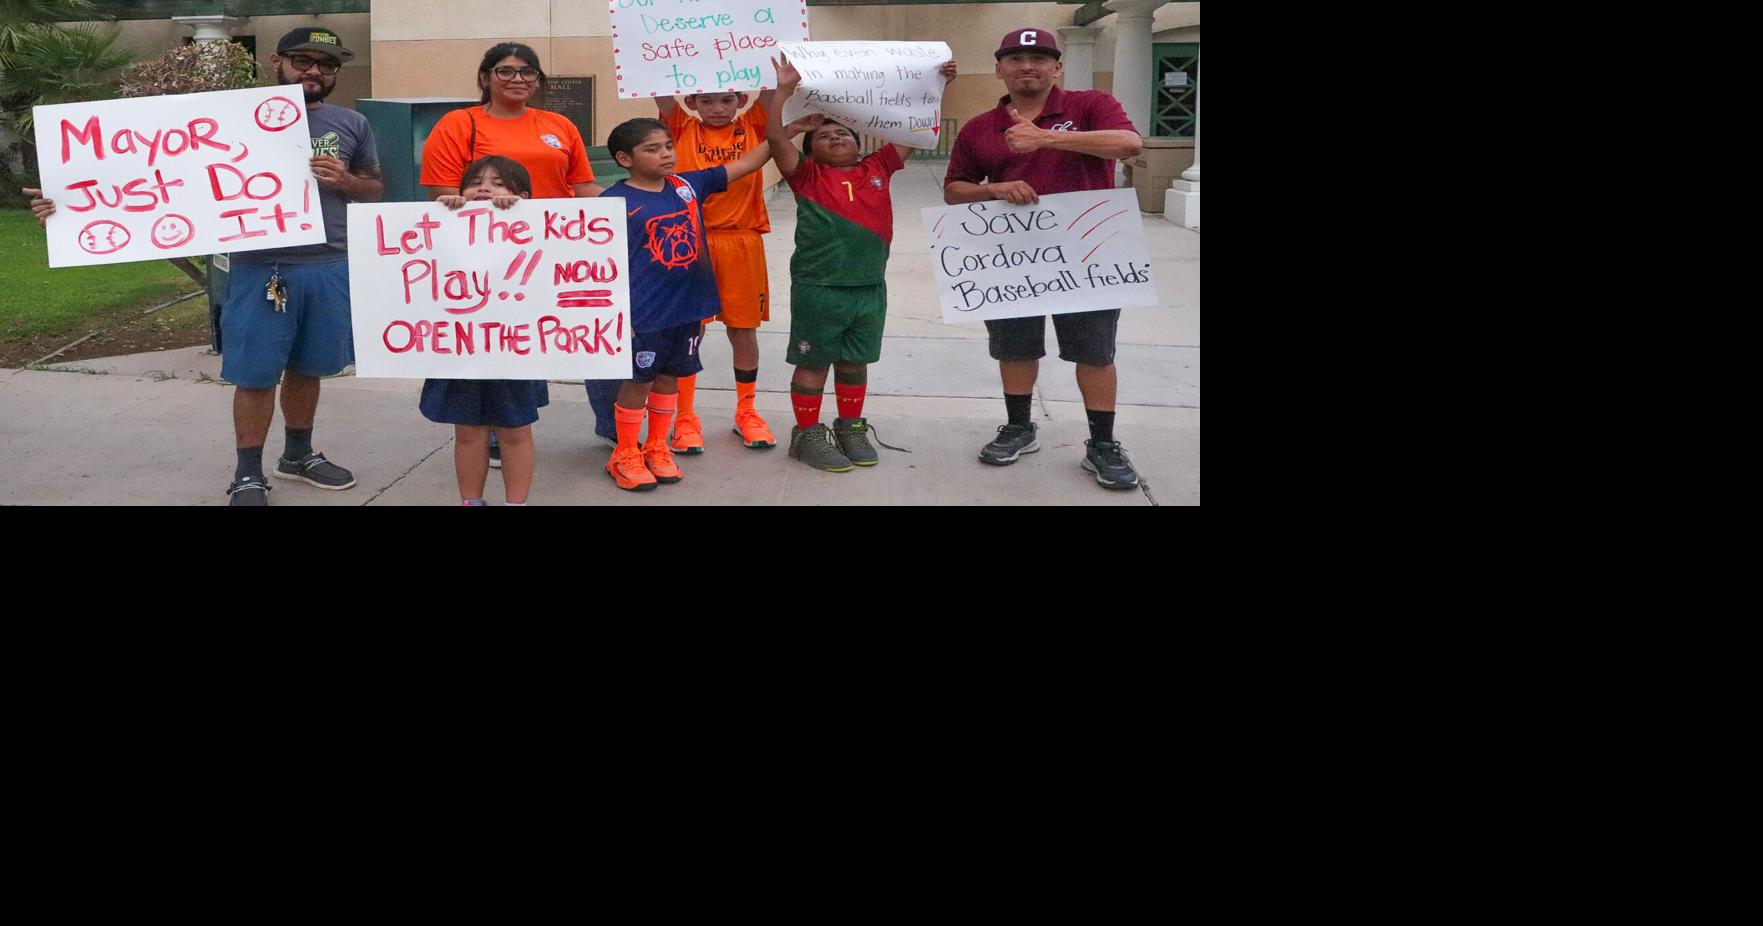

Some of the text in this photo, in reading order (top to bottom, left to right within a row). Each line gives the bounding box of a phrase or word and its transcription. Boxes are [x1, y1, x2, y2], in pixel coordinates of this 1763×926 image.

[640, 7, 774, 35] Deserve a
[713, 31, 778, 60] place
[1020, 31, 1037, 46] C
[783, 45, 941, 64] Why even waste
[665, 60, 761, 88] to play
[834, 67, 886, 89] making
[896, 65, 922, 81] the
[805, 89, 935, 108] Baseball fields to
[865, 115, 902, 130] them
[205, 163, 283, 201] Do
[841, 181, 853, 202] 7
[376, 212, 441, 256] Let
[457, 208, 533, 246] The
[960, 202, 1058, 236] Save
[952, 270, 1081, 312] Baseball
[382, 320, 475, 355] OPEN
[478, 322, 531, 356] THE
